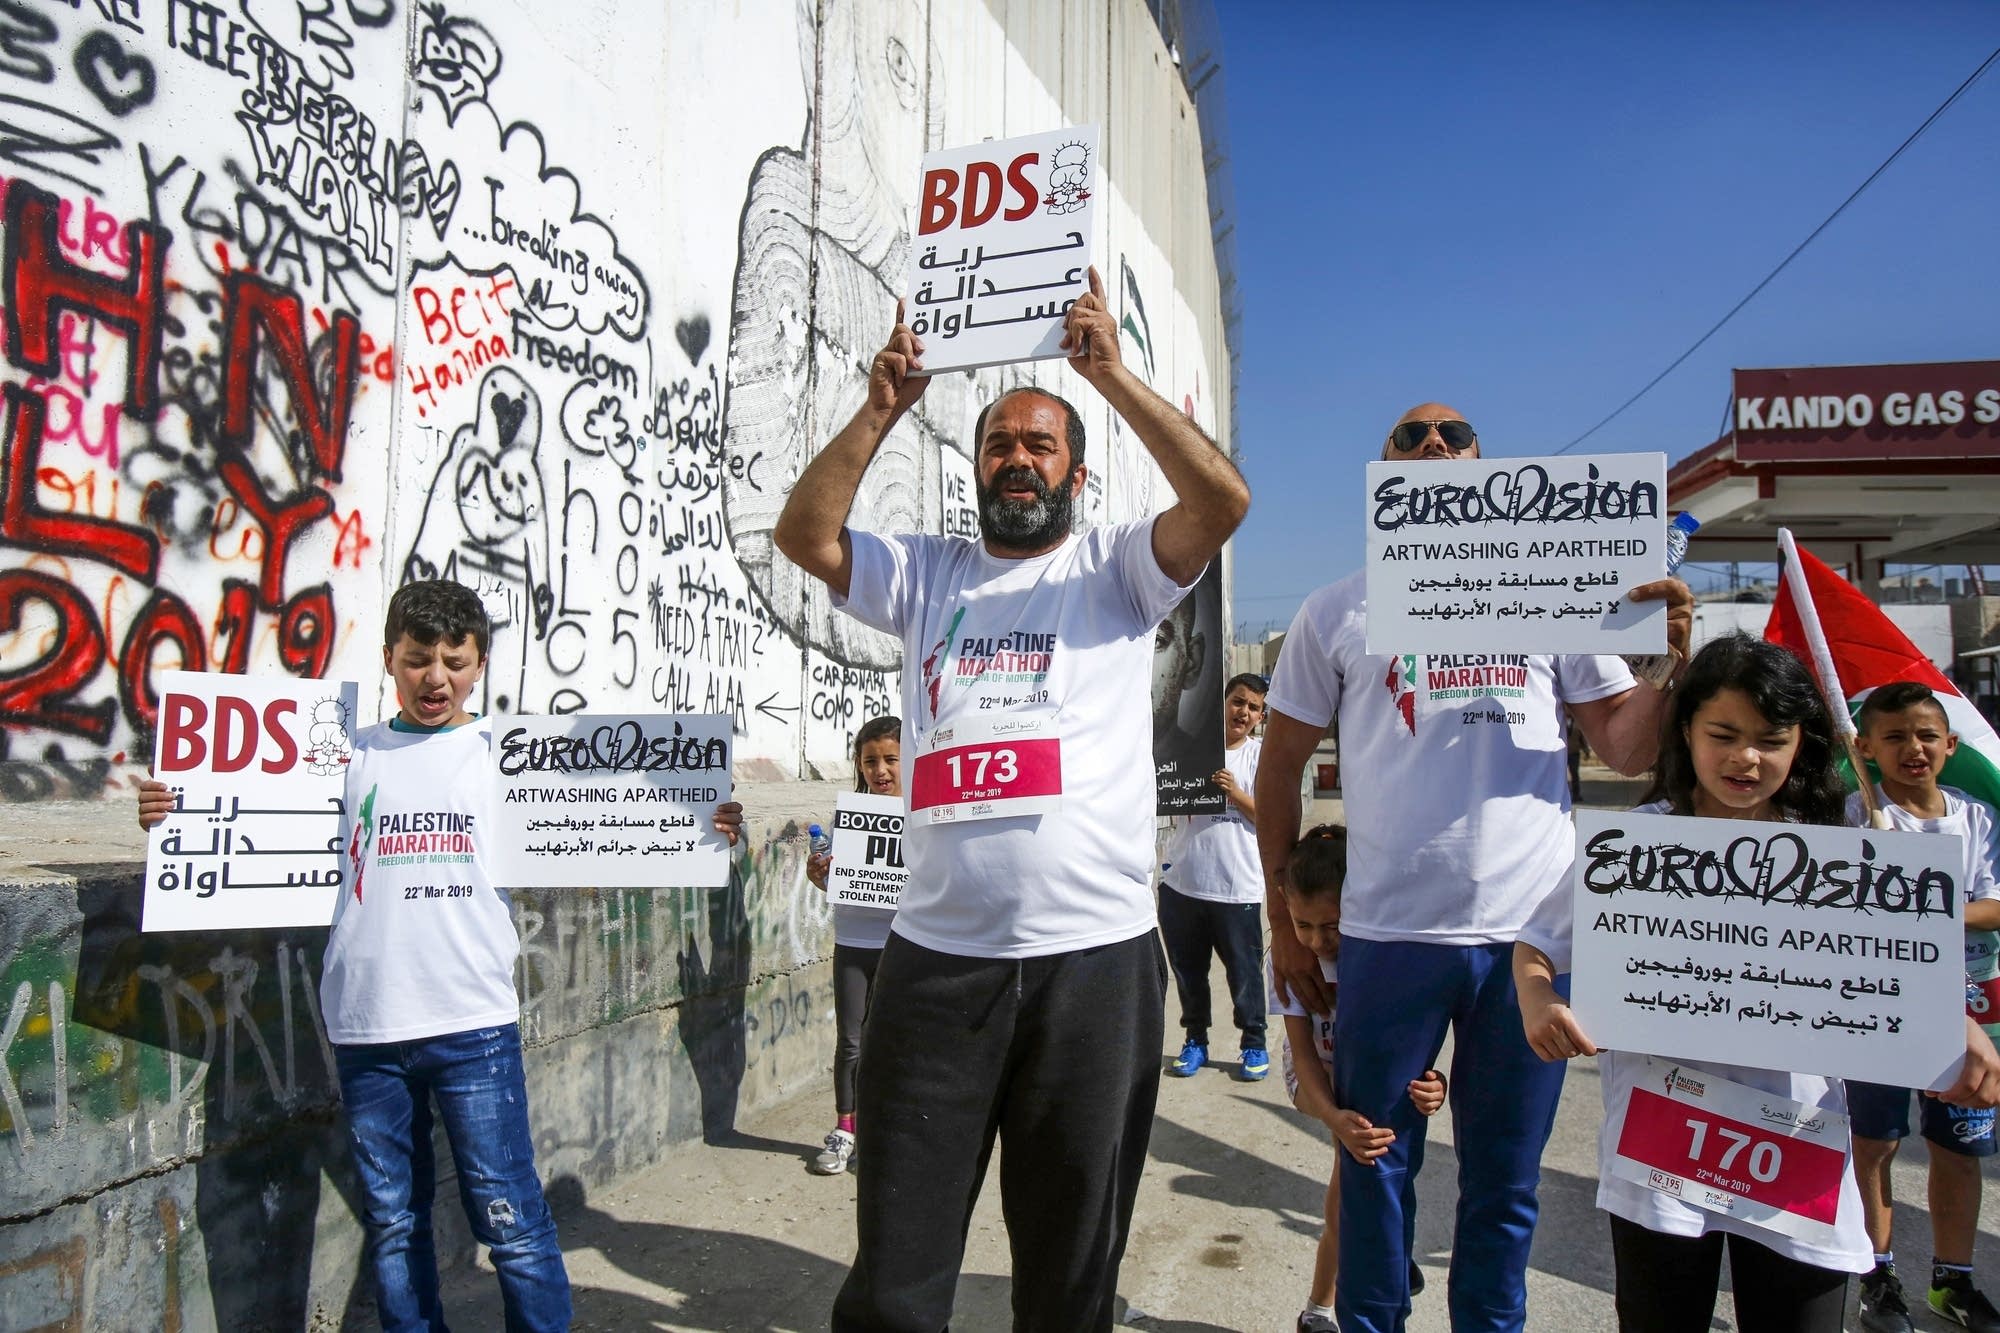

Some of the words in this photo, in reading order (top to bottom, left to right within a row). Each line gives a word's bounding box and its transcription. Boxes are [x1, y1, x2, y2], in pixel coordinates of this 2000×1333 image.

[918, 152, 1039, 236] BDS
[919, 232, 1084, 272] حرية
[914, 267, 1082, 305] عدالة
[510, 307, 639, 399] Freedom
[1738, 394, 1873, 430] KANDO
[1882, 391, 1965, 426] GAS
[946, 472, 966, 503] WE
[1382, 541, 1519, 560] ARTWASHING
[1527, 539, 1647, 558] APARTHEID
[1409, 573, 1492, 592] يوروفيجين
[1498, 572, 1568, 590] مسابقة
[1573, 571, 1619, 592] قاطع
[1496, 601, 1546, 619] جرائم
[1552, 602, 1602, 619] تبيض
[1607, 601, 1620, 614] لا
[652, 661, 695, 715] CALL
[813, 664, 887, 694] CARBONARA
[1428, 667, 1528, 690] MARATHON
[979, 697, 1000, 709] 22nd
[1430, 688, 1470, 700] FREEDOM
[1472, 688, 1483, 698] OF
[1485, 687, 1525, 698] MOVEMENT
[811, 692, 853, 730] COMO
[863, 694, 891, 724] FOR
[1462, 711, 1483, 724] 22nd
[1487, 711, 1505, 723] Mar
[1507, 712, 1525, 724] 2019
[160, 693, 298, 775] BDS
[947, 749, 1018, 788] 173
[505, 788, 617, 803] ARTWASHING
[623, 788, 718, 803] APARTHEID
[380, 812, 475, 835] PALESTINE
[527, 815, 595, 831] يوروفيجين
[599, 815, 655, 831] مسابقة
[659, 815, 695, 832] قاطع
[840, 812, 904, 833] BOYCO
[160, 828, 344, 856] عدالة
[378, 834, 475, 856] MARATHON
[597, 840, 637, 856] جرائم
[641, 841, 681, 855] تبيض
[686, 840, 696, 852] لا
[378, 855, 414, 867] FREEDOM
[416, 855, 427, 864] OF
[429, 855, 474, 864] MOVEMENT
[158, 862, 343, 898] مساواة
[835, 867, 855, 877] END
[424, 886, 445, 898] Mar
[447, 885, 473, 897] 2019
[839, 890, 875, 903] STOLEN
[1593, 912, 1768, 947] ARTWASHING
[1778, 929, 1939, 963] APARTHEID
[1626, 957, 1733, 984] يوروفيجين
[1739, 962, 1832, 990] مسابقة
[1839, 976, 1901, 1000] قاطع
[1738, 1000, 1803, 1026] جرائم
[1811, 1011, 1877, 1035] تبيض
[1886, 1015, 1902, 1033] لا
[1677, 1076, 1705, 1089] PALESTINE
[1686, 1119, 1782, 1183] 170
[1696, 1168, 1713, 1180] 22nd
[1713, 1175, 1731, 1187] Mar
[1731, 1180, 1751, 1193] 2019
